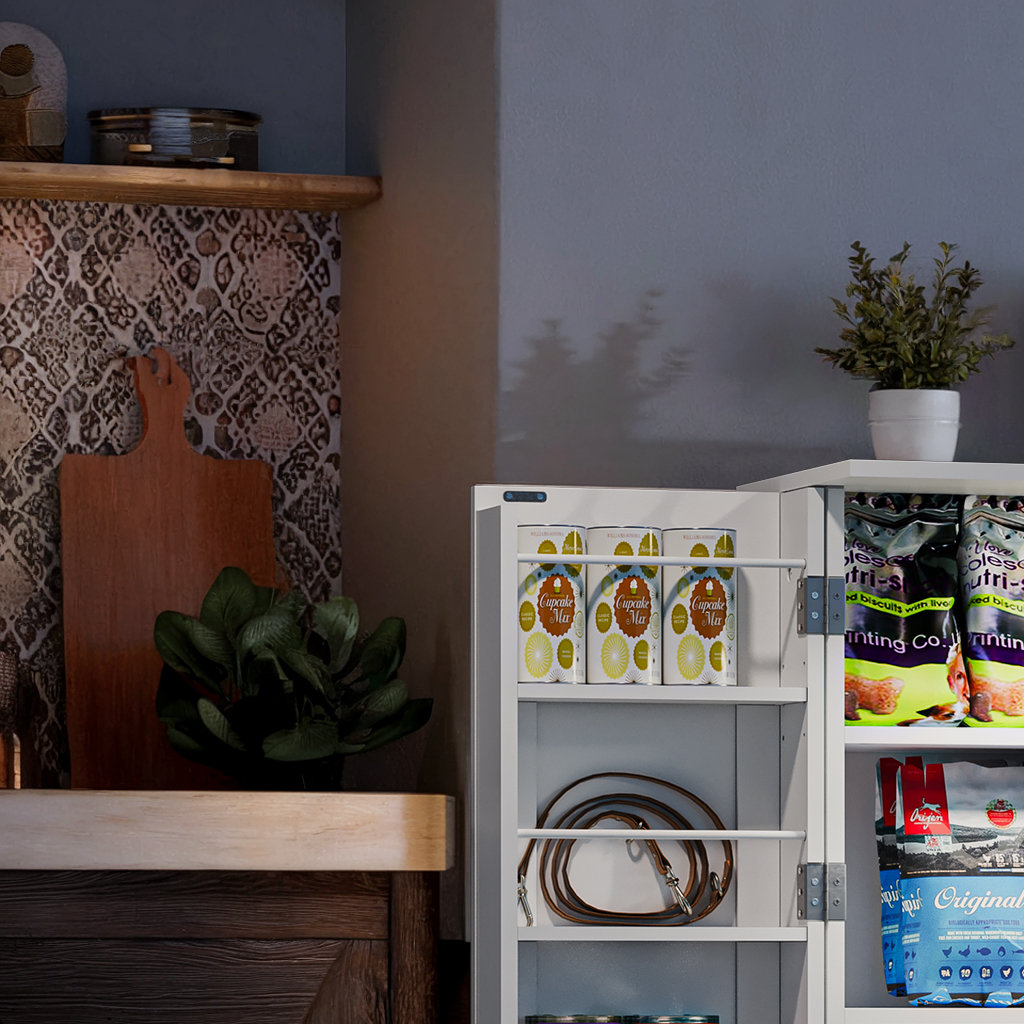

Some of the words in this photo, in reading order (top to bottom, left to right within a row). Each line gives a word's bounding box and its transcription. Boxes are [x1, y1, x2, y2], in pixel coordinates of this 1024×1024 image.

[540, 593, 573, 610] Cupcake
[616, 594, 649, 612] Cupcake
[692, 596, 726, 613] Cupcake
[860, 594, 903, 613] biscuits
[905, 602, 928, 613] with
[550, 608, 571, 624] Mix
[626, 609, 647, 625] Mix
[702, 611, 722, 626] Mix
[846, 630, 906, 654] inting
